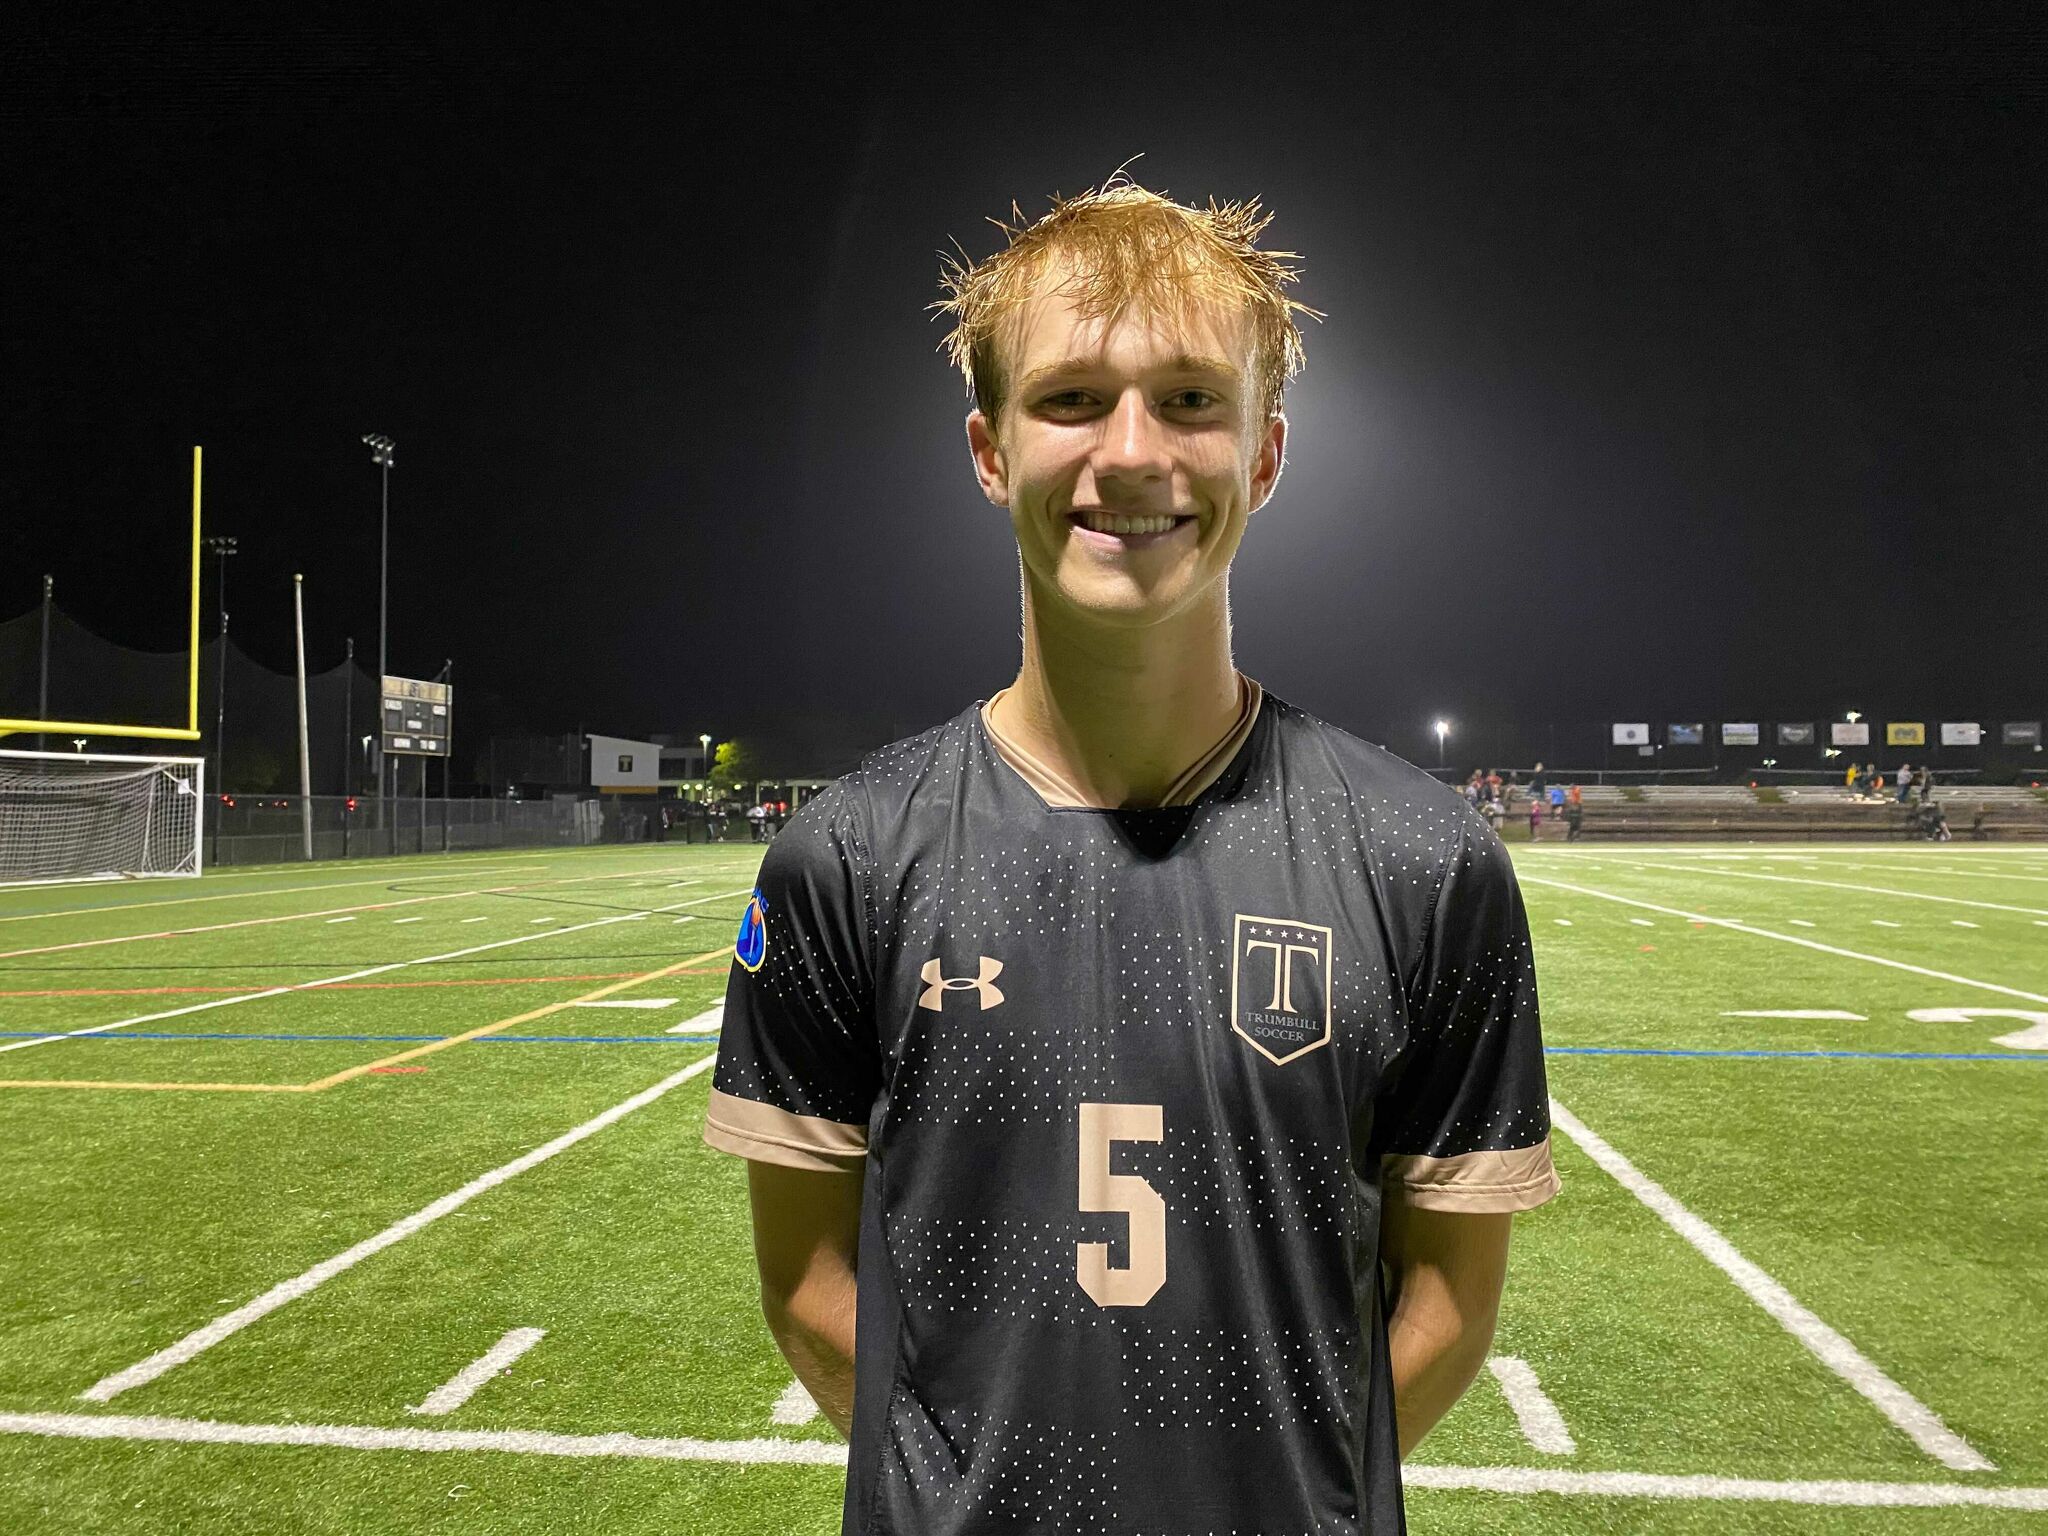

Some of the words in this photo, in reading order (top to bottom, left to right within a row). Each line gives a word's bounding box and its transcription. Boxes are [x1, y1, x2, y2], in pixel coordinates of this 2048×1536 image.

[1246, 939, 1319, 1014] T
[1246, 1011, 1320, 1031] TRUMBULL
[1254, 1026, 1305, 1042] SOCCER
[1076, 1102, 1167, 1308] 5
